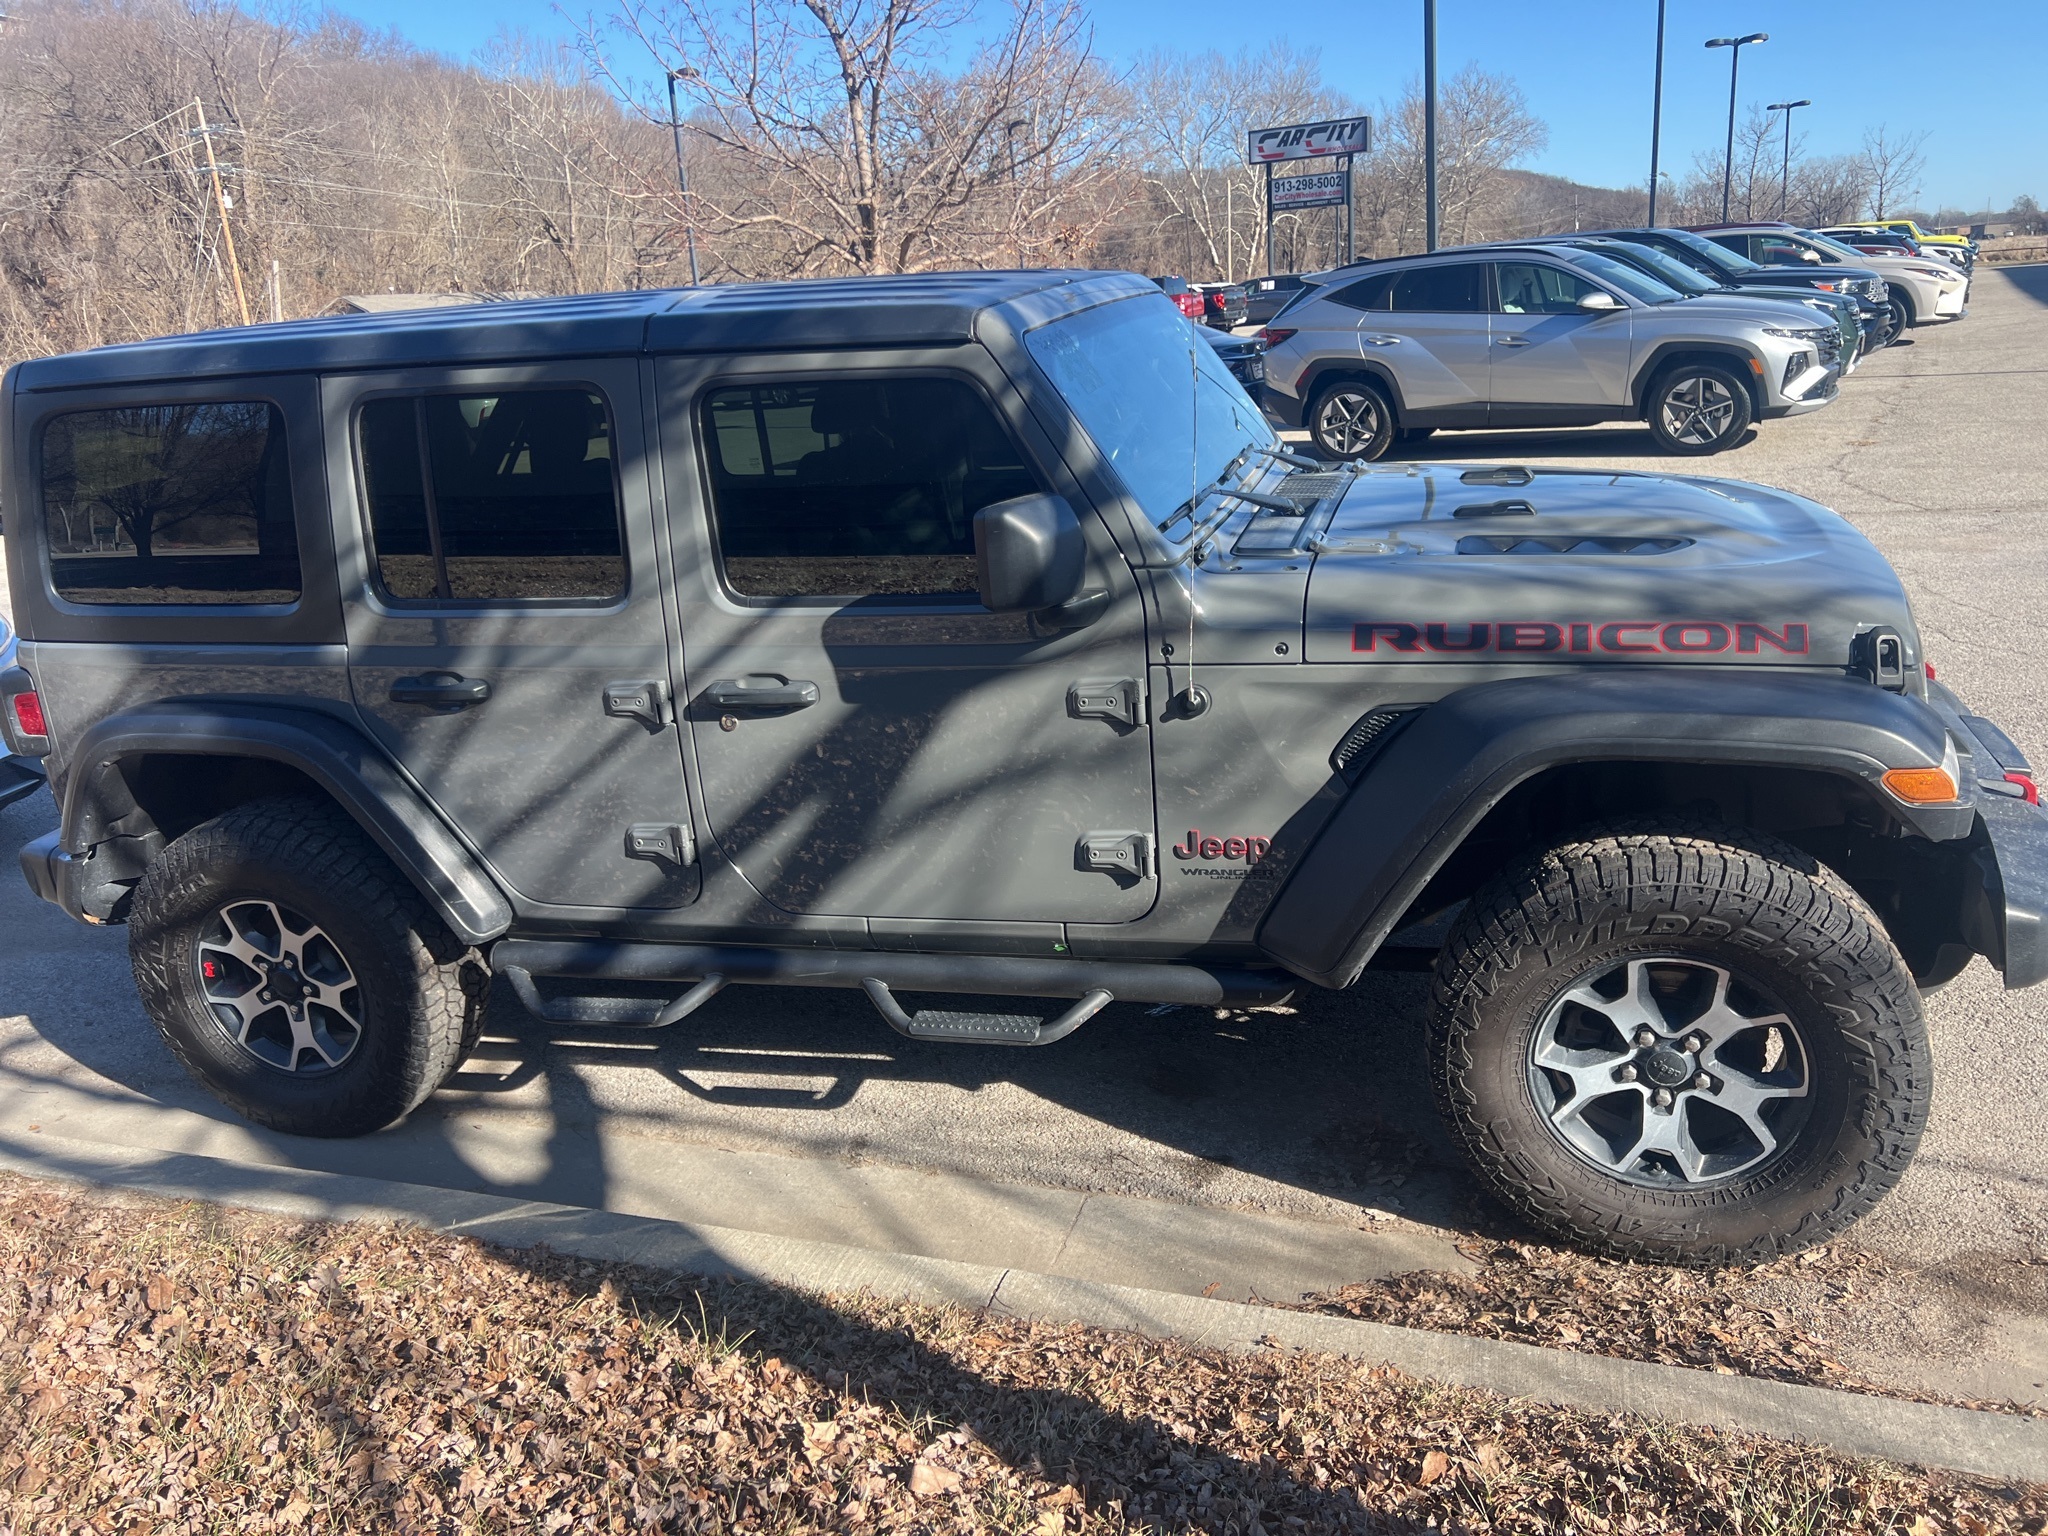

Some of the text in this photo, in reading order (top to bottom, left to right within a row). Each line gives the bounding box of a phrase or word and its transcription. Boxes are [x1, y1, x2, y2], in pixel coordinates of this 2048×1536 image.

[1274, 175, 1342, 193] 913-298-5002
[1274, 189, 1343, 202] CarCityWholesale.com
[1351, 622, 1810, 655] RUBICON
[1172, 829, 1272, 866] Jeep
[1180, 867, 1275, 876] WRANGLER
[1652, 1059, 1682, 1077] Jeep
